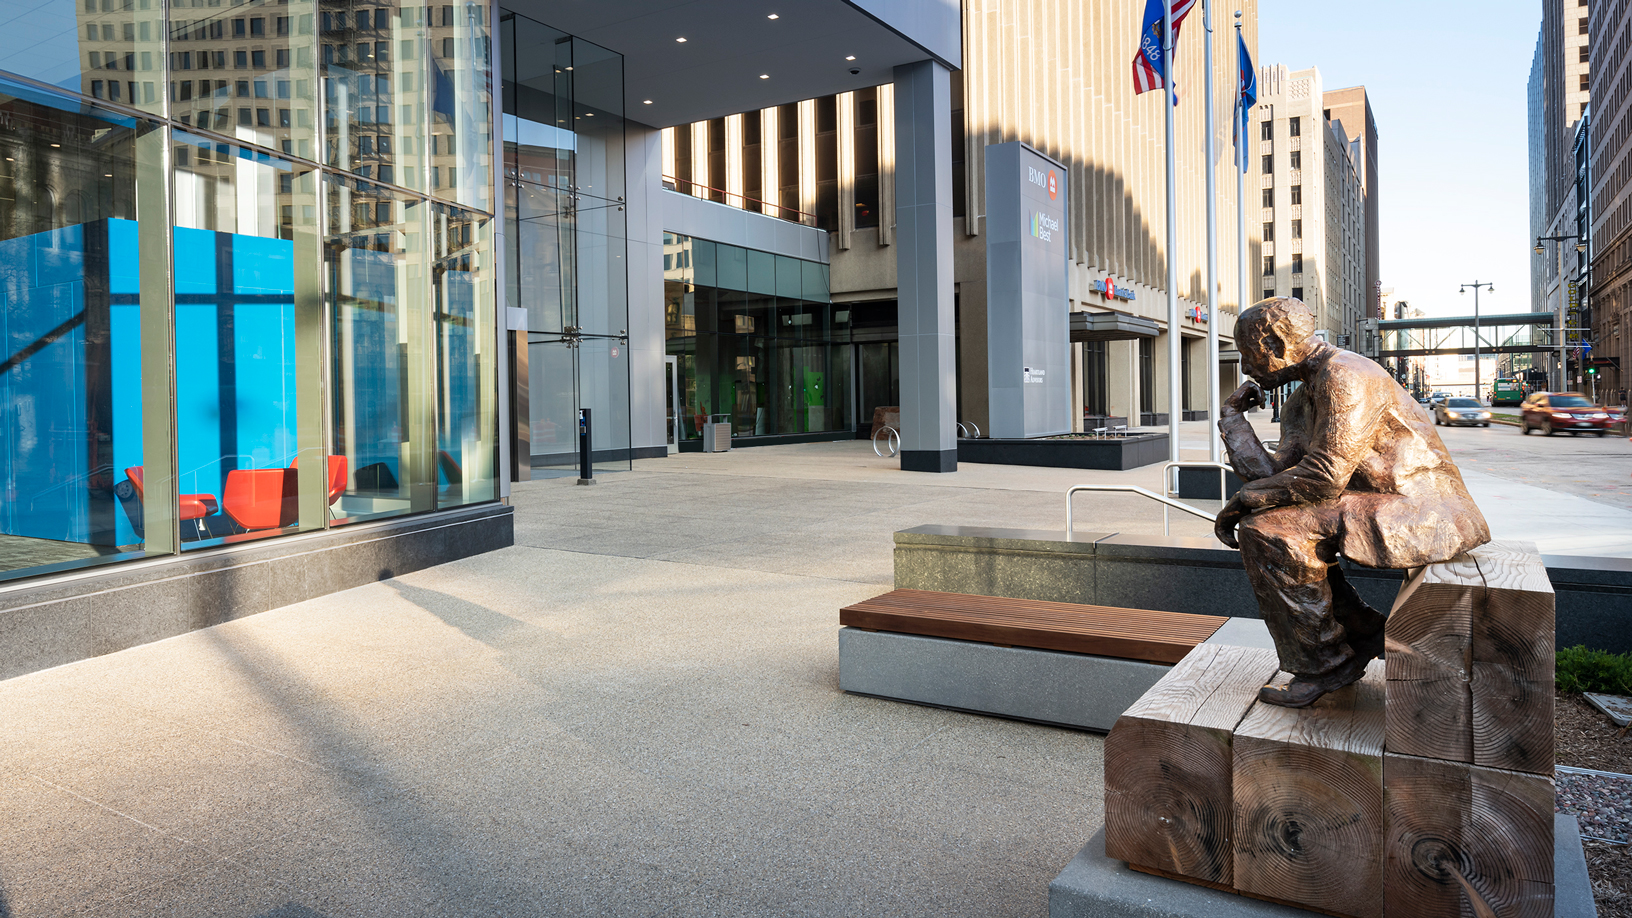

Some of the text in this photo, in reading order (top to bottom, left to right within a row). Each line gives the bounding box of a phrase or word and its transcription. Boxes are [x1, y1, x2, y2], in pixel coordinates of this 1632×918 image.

[1142, 34, 1160, 60] 1848
[1028, 166, 1046, 188] BMO
[1039, 211, 1059, 232] Michael
[1039, 226, 1051, 242] Best
